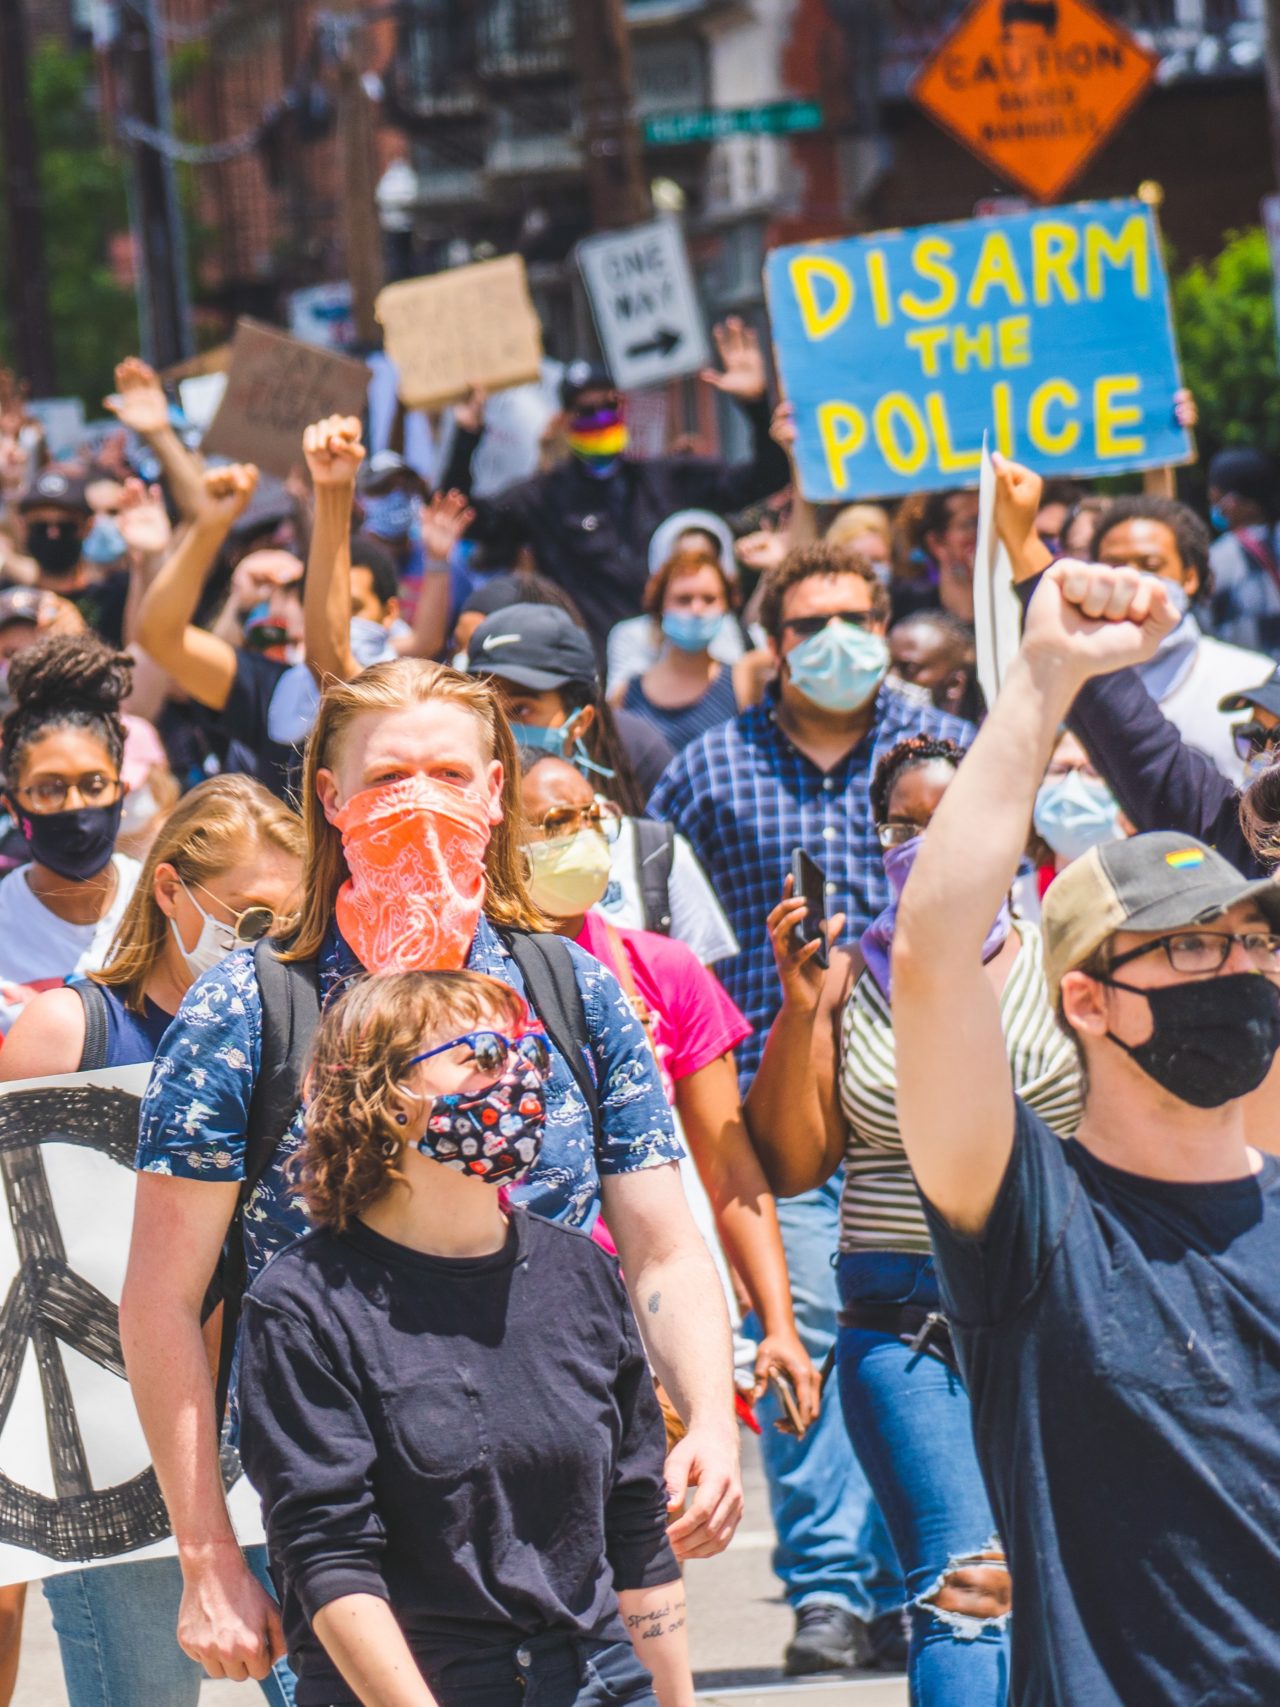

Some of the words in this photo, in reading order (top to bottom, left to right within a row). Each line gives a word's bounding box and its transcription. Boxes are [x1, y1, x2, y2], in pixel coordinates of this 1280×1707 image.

[943, 43, 1124, 92] CAUTION
[602, 240, 665, 287] ONE
[788, 215, 1151, 341] DISARM
[614, 278, 676, 321] WAY
[905, 315, 1032, 377] THE
[816, 376, 1147, 492] POLICE
[642, 1622, 664, 1640] all
